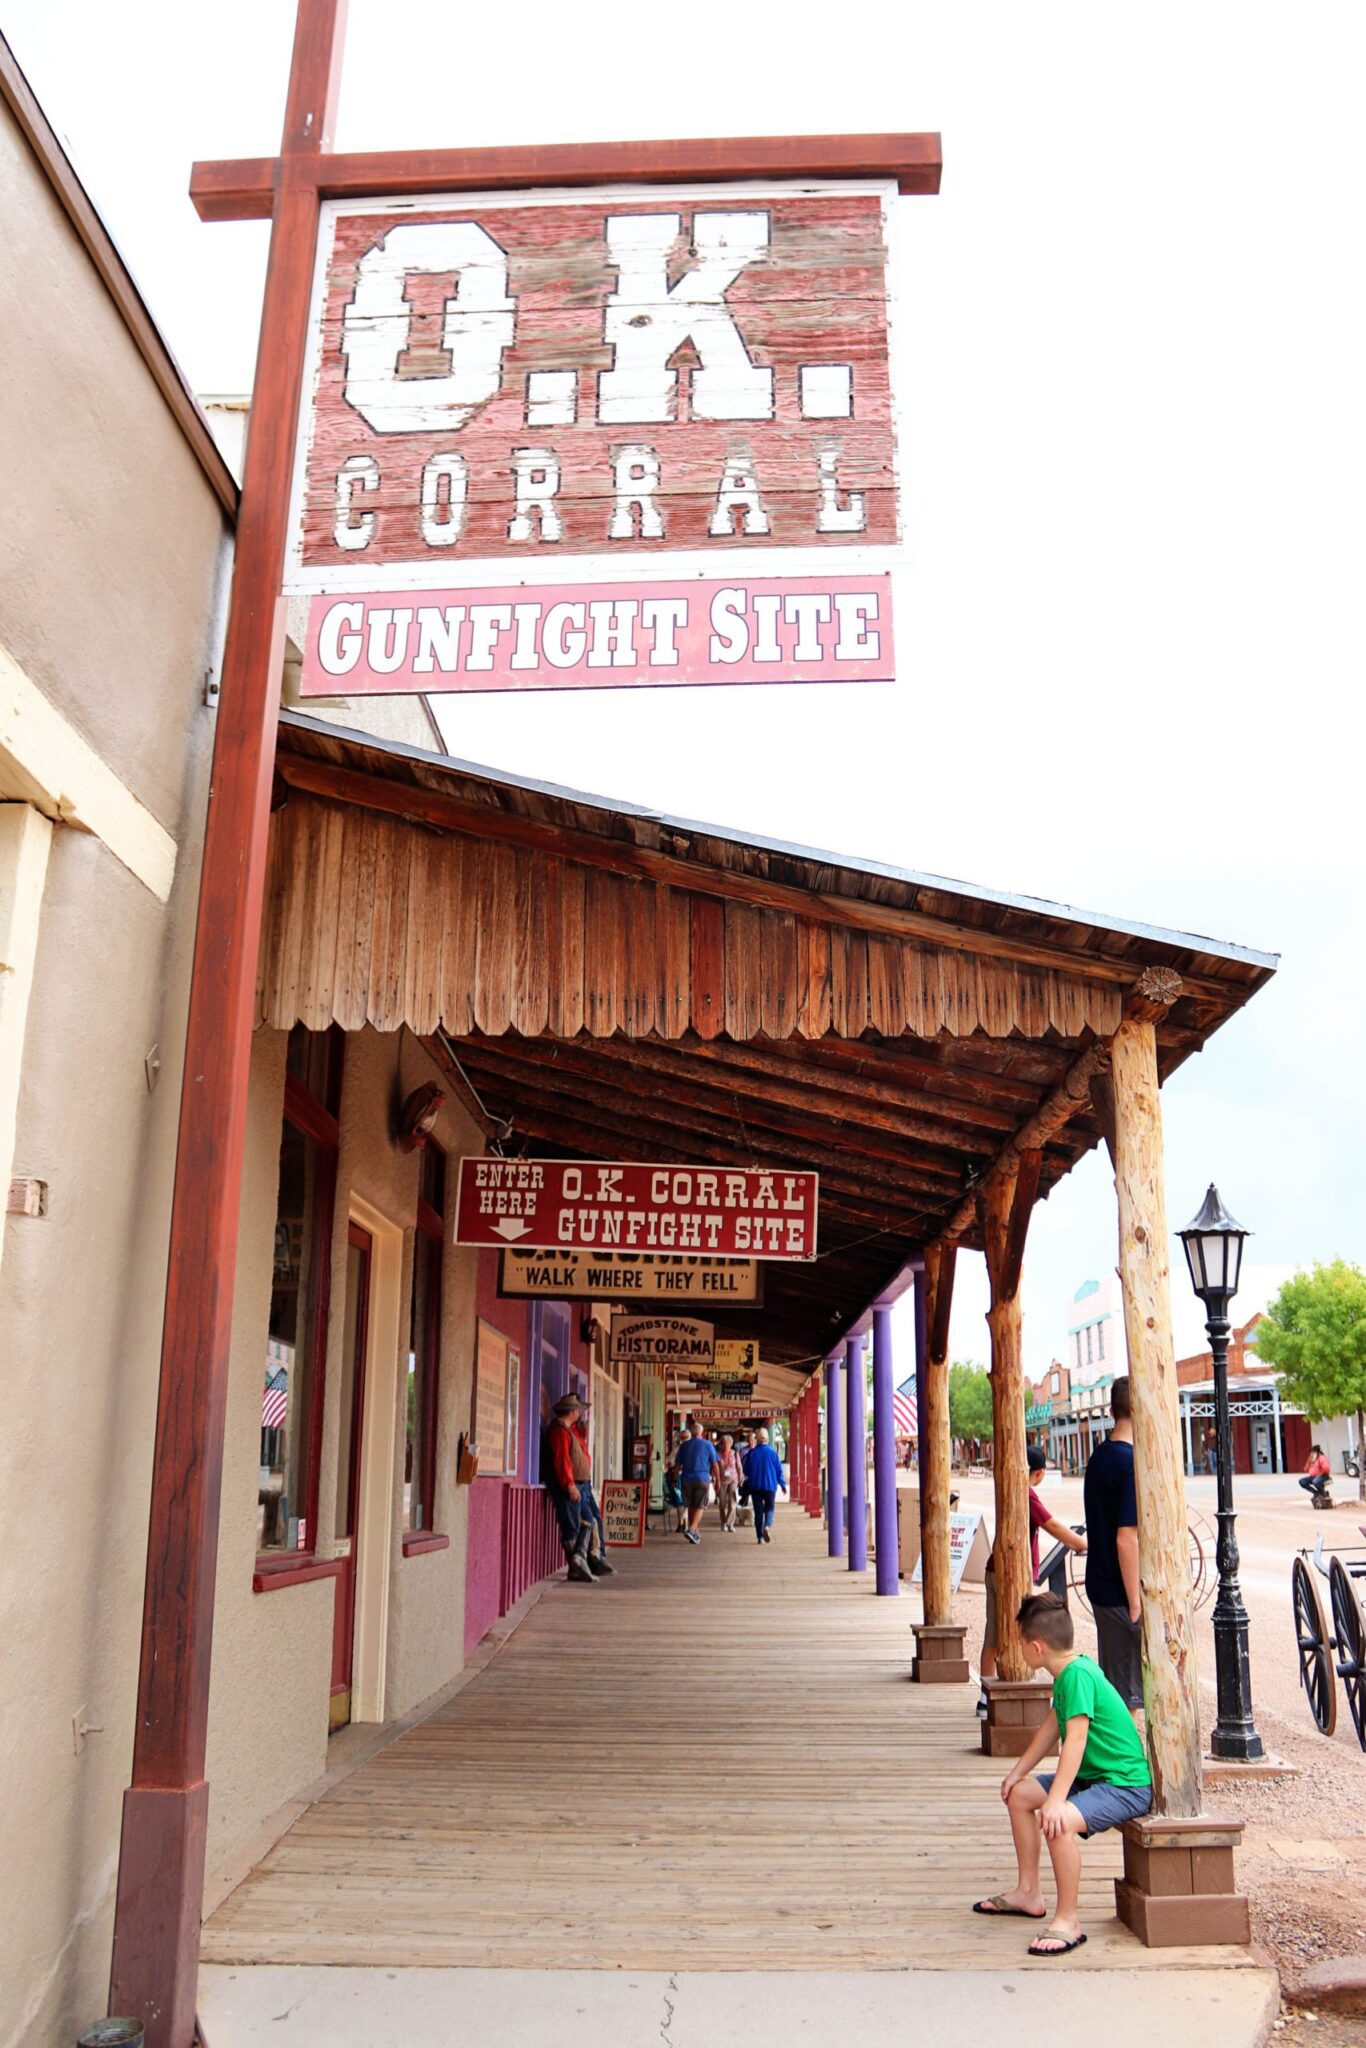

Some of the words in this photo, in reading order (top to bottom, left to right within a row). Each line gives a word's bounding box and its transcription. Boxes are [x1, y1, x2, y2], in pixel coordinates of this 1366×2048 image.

[341, 209, 854, 435] O.K.
[334, 438, 867, 551] CORRAL
[317, 597, 689, 675] GUNFIGHT
[708, 588, 881, 664] SITE
[475, 1163, 545, 1189] ENTER
[562, 1167, 636, 1203] O.K.
[651, 1171, 805, 1211] CORRAL
[479, 1190, 537, 1216] HERE
[558, 1208, 723, 1248] GUNFIGHT
[734, 1216, 805, 1252] SITE
[587, 1268, 643, 1289] WHERE
[654, 1271, 694, 1290] THEY
[619, 1319, 699, 1337] TOMBSTONE
[617, 1337, 712, 1355] HISTORAMA
[708, 1371, 739, 1380] GIFTS
[694, 1409, 716, 1418] OLD
[720, 1409, 747, 1418] TIME
[749, 1407, 789, 1417] PHOTOS
[607, 1487, 628, 1497] OPEN
[609, 1532, 634, 1541] MORE
